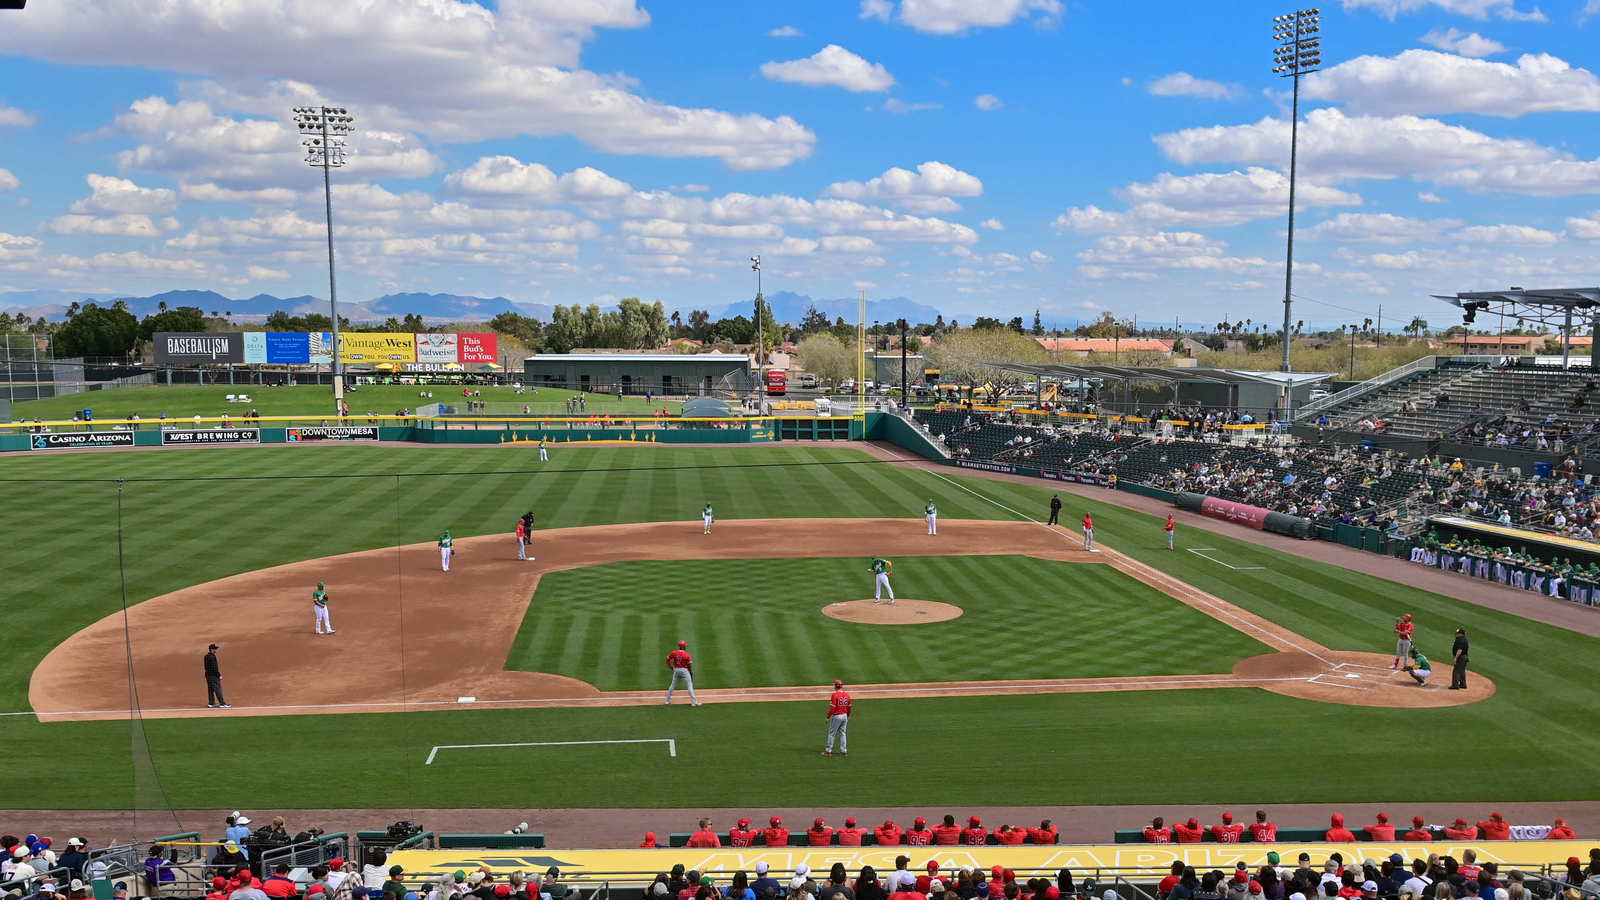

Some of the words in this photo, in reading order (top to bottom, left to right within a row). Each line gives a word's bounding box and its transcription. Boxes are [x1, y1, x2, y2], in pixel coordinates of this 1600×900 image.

[168, 338, 228, 360] BASEBALLISM
[34, 435, 47, 448] 25
[733, 837, 749, 847] 97
[1222, 831, 1238, 843] 37
[1258, 830, 1275, 842] 44
